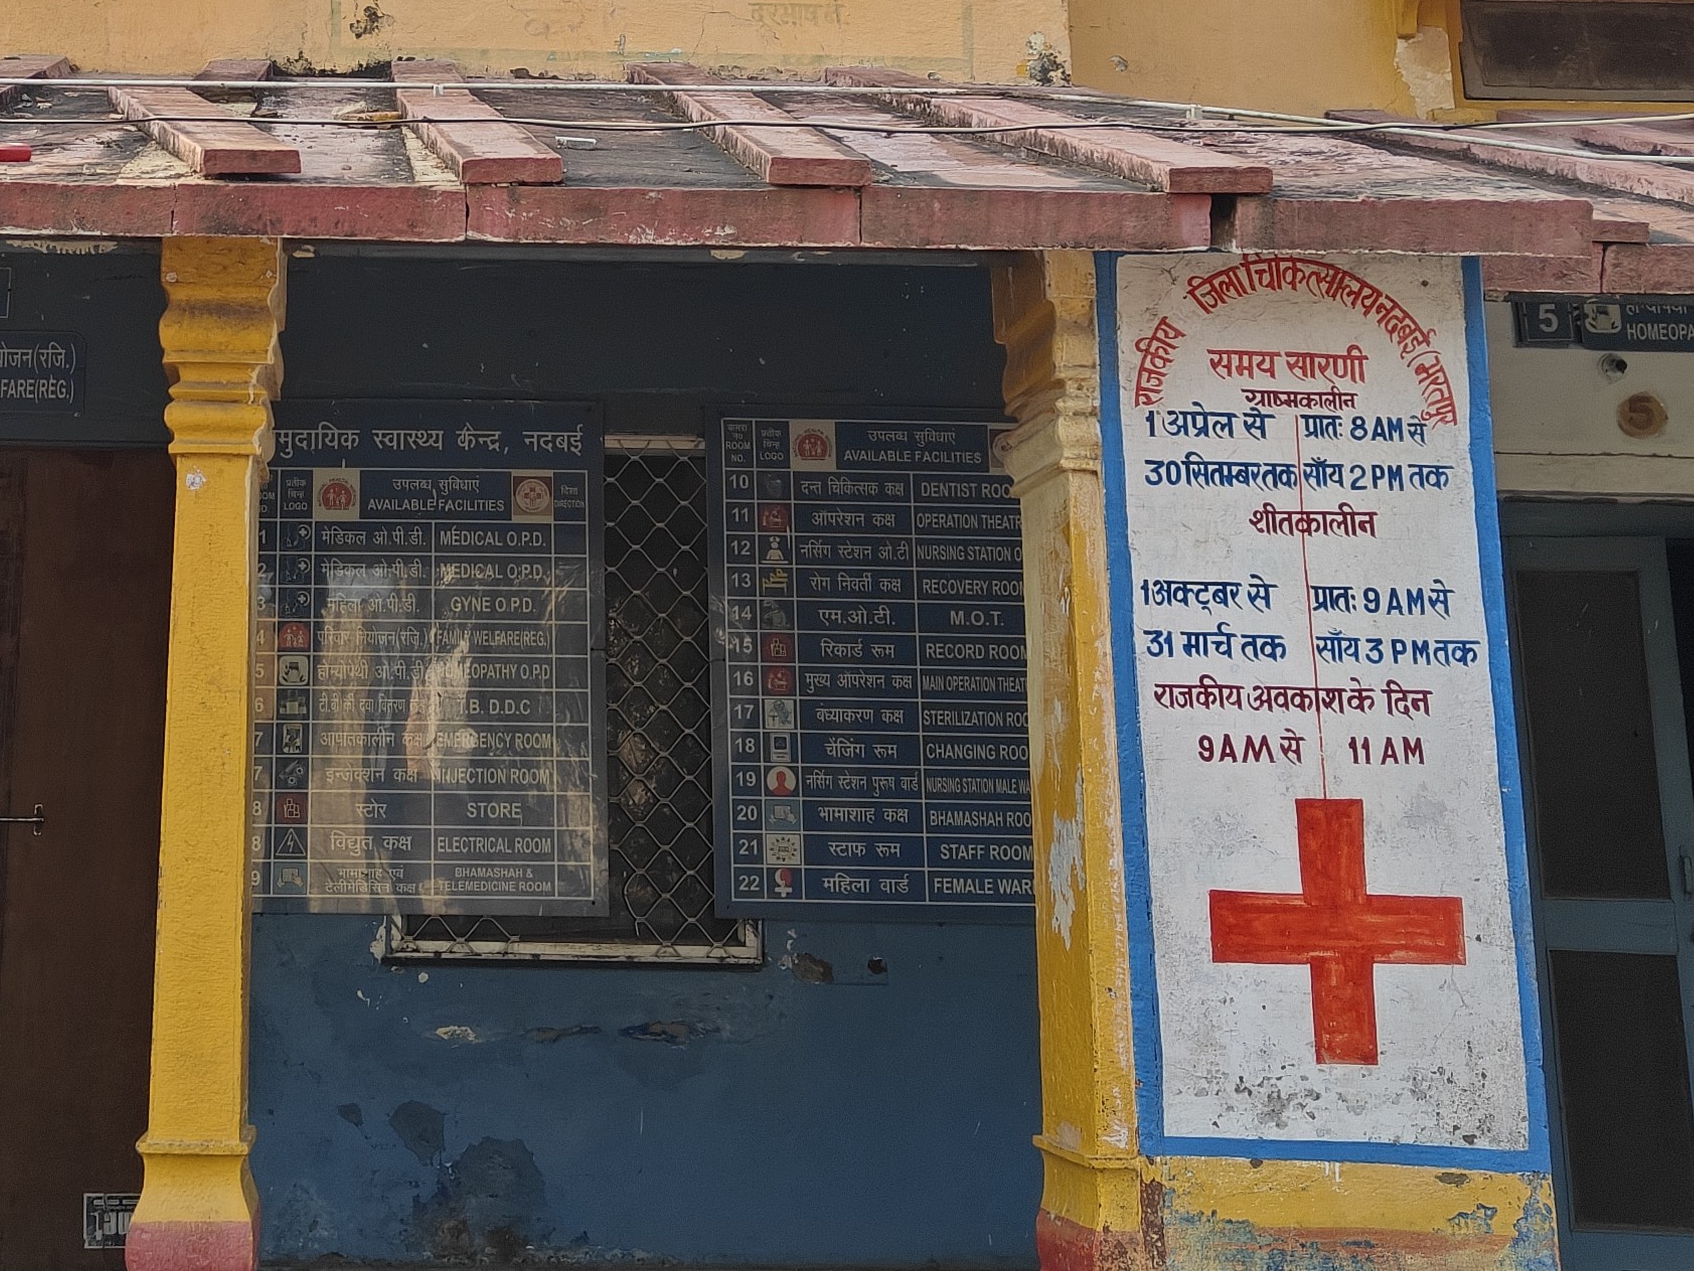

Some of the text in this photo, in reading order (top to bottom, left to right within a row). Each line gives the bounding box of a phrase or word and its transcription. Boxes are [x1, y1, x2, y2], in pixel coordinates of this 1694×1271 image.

[1539, 304, 1559, 332] 5
[1134, 315, 1187, 408] राजकीय
[1186, 265, 1249, 314] जिला
[1375, 293, 1437, 360] नदबई
[1206, 343, 1369, 384] समय सारणी
[1145, 410, 1156, 437] 1
[1162, 401, 1240, 439] अप्रेल
[1242, 406, 1276, 440] से
[1350, 415, 1368, 441] 8
[1370, 416, 1404, 442] AM
[1407, 415, 1427, 447] से
[371, 429, 444, 451] स्वास्थ्य
[522, 424, 583, 456] नदबई
[726, 441, 751, 450] ROOM
[759, 452, 784, 461] LOGO
[844, 449, 982, 464] AVAILABLE FACILITIES
[1144, 451, 1454, 491] 30 सितम्बर तक 2 PM तक
[729, 474, 749, 489] 10
[884, 482, 904, 496] कक्ष
[921, 482, 978, 497] DENTIST
[367, 498, 505, 512] AVAILABLE FACILITIES
[731, 508, 749, 523] 11
[871, 513, 895, 527] कक्ष
[916, 513, 978, 528] OPERATION
[1248, 502, 1378, 538] शीतकालीन
[321, 525, 366, 545] मेडिकल
[440, 531, 546, 547] MEDICAL O.P.D.
[730, 539, 872, 559] 12 स्टेशन
[916, 545, 1011, 562] NURSING STATION
[321, 558, 366, 578] मेडिकल
[440, 563, 546, 580] MEDICAL O.P.D.
[731, 572, 901, 592] 13 रोग कक्ष
[923, 579, 988, 595] RECOVERY
[327, 593, 362, 612] महिला
[450, 597, 537, 613] GYNE O.P.D.
[1247, 574, 1278, 613] से
[1363, 587, 1380, 614] 9
[1386, 587, 1425, 616] AM
[1428, 579, 1455, 620] से
[731, 607, 752, 621] 14
[950, 610, 1004, 626] M.O.T.
[733, 638, 895, 658] 15 रिकार्ड रूम
[926, 643, 985, 659] RECORD
[1143, 622, 1481, 668] 31 मार्च तक 3 PM तक
[733, 672, 754, 687] 16
[891, 675, 912, 689] कक्ष
[922, 675, 996, 692] MAIN OPERATION
[1154, 674, 1244, 710] राजकीय
[1347, 677, 1375, 715] के
[1381, 679, 1434, 721] दिन
[733, 705, 904, 724] 17 कक्ष
[923, 709, 1003, 726] STERILIZATION
[320, 726, 395, 747] आपातकालीन
[436, 732, 552, 749] EMERGENCY ROOM
[734, 738, 755, 753] 18
[872, 744, 897, 759] रूम
[926, 743, 996, 759] CHANGING
[1280, 728, 1425, 765] से 11 AM
[392, 767, 418, 783] कक्ष
[438, 767, 550, 785] INJECTION ROOM
[735, 772, 756, 787] 19
[926, 777, 1017, 794] NURSING STATION MALE
[355, 798, 387, 818] स्टोर
[466, 802, 522, 819] STORE
[736, 806, 758, 821] 20
[883, 808, 909, 823] कक्ष
[930, 810, 1003, 827] BHAMASHAH
[382, 835, 412, 851] कक्ष
[437, 836, 552, 854] ELECTRICAL ROOM
[738, 840, 902, 859] 21 स्टाफ रूम
[940, 844, 1033, 861] STAFF ROOM
[454, 867, 523, 878] BHAMASHAH
[395, 882, 416, 894] कक्ष
[439, 881, 552, 892] TELEMEDICINE ROOM
[739, 873, 909, 895] 22 महिला वार्ड
[934, 877, 994, 894] FEMALE
